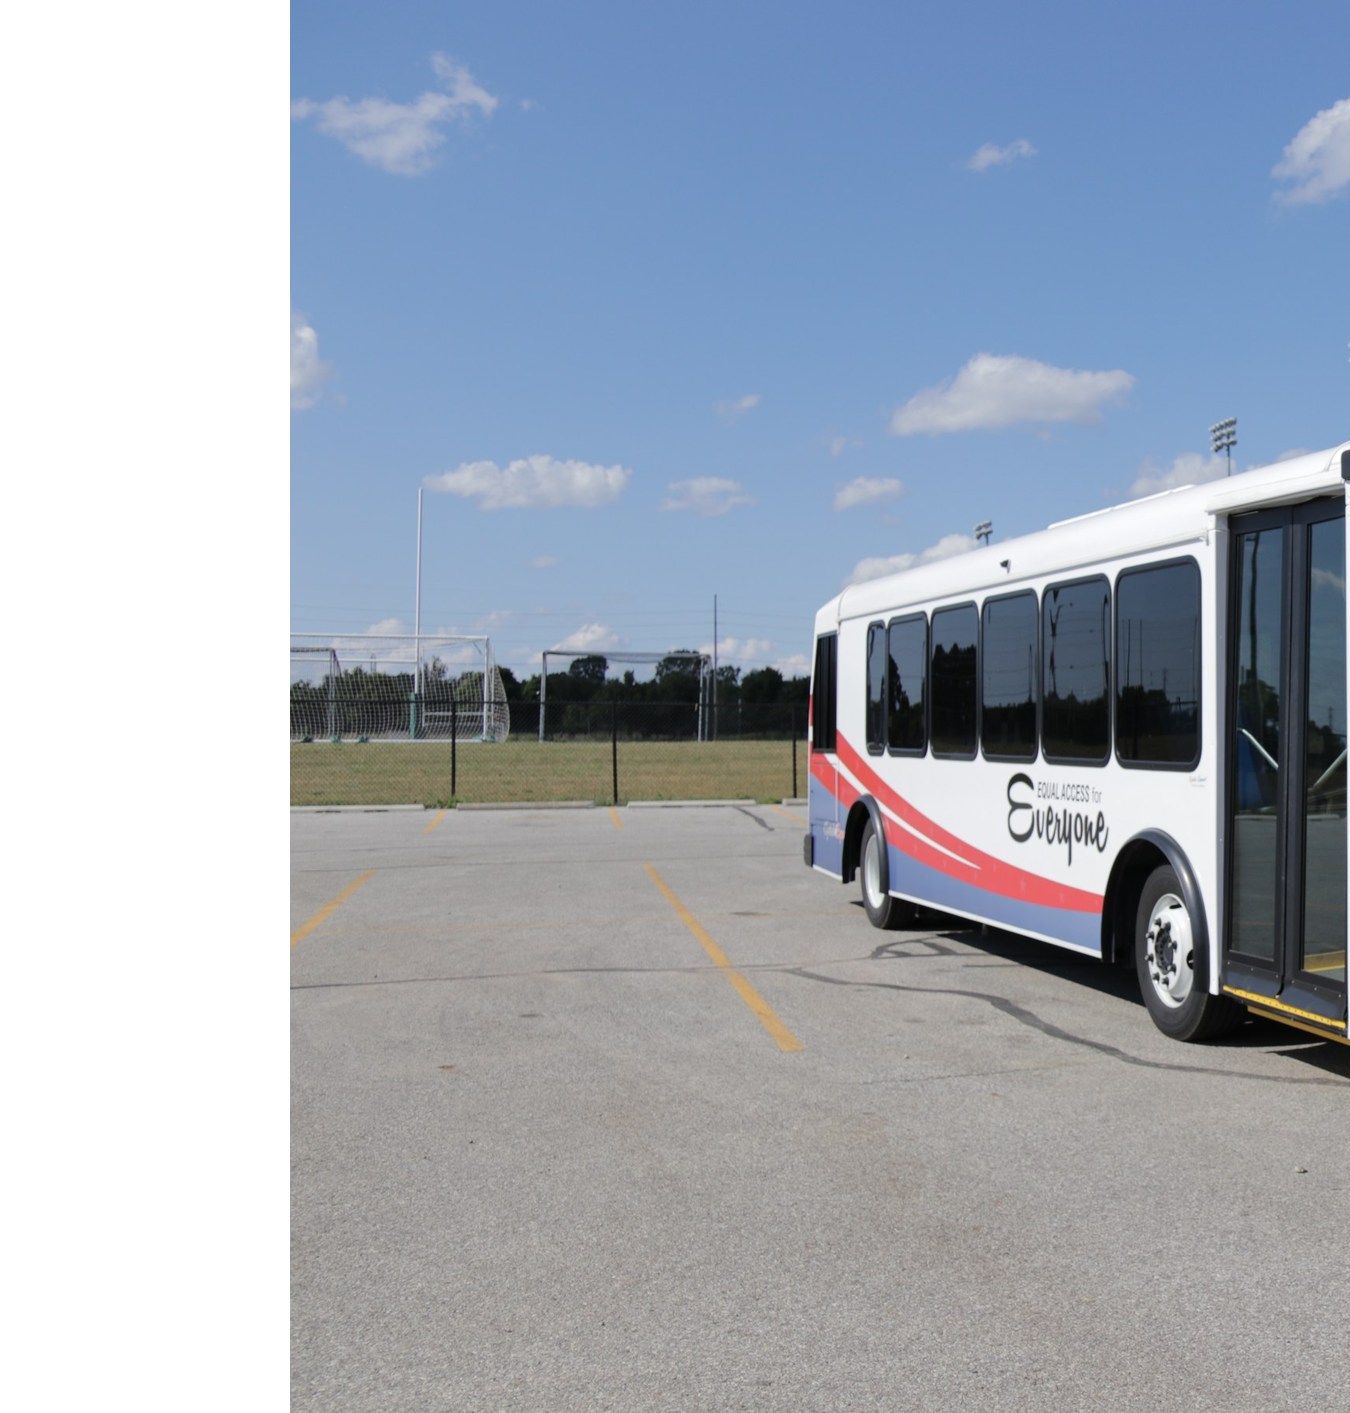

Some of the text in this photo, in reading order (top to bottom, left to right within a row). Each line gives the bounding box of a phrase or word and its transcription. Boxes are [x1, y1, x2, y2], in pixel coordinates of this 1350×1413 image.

[1007, 772, 1109, 867] Everyone
[1037, 781, 1103, 804] EQUAL ACCESS for
